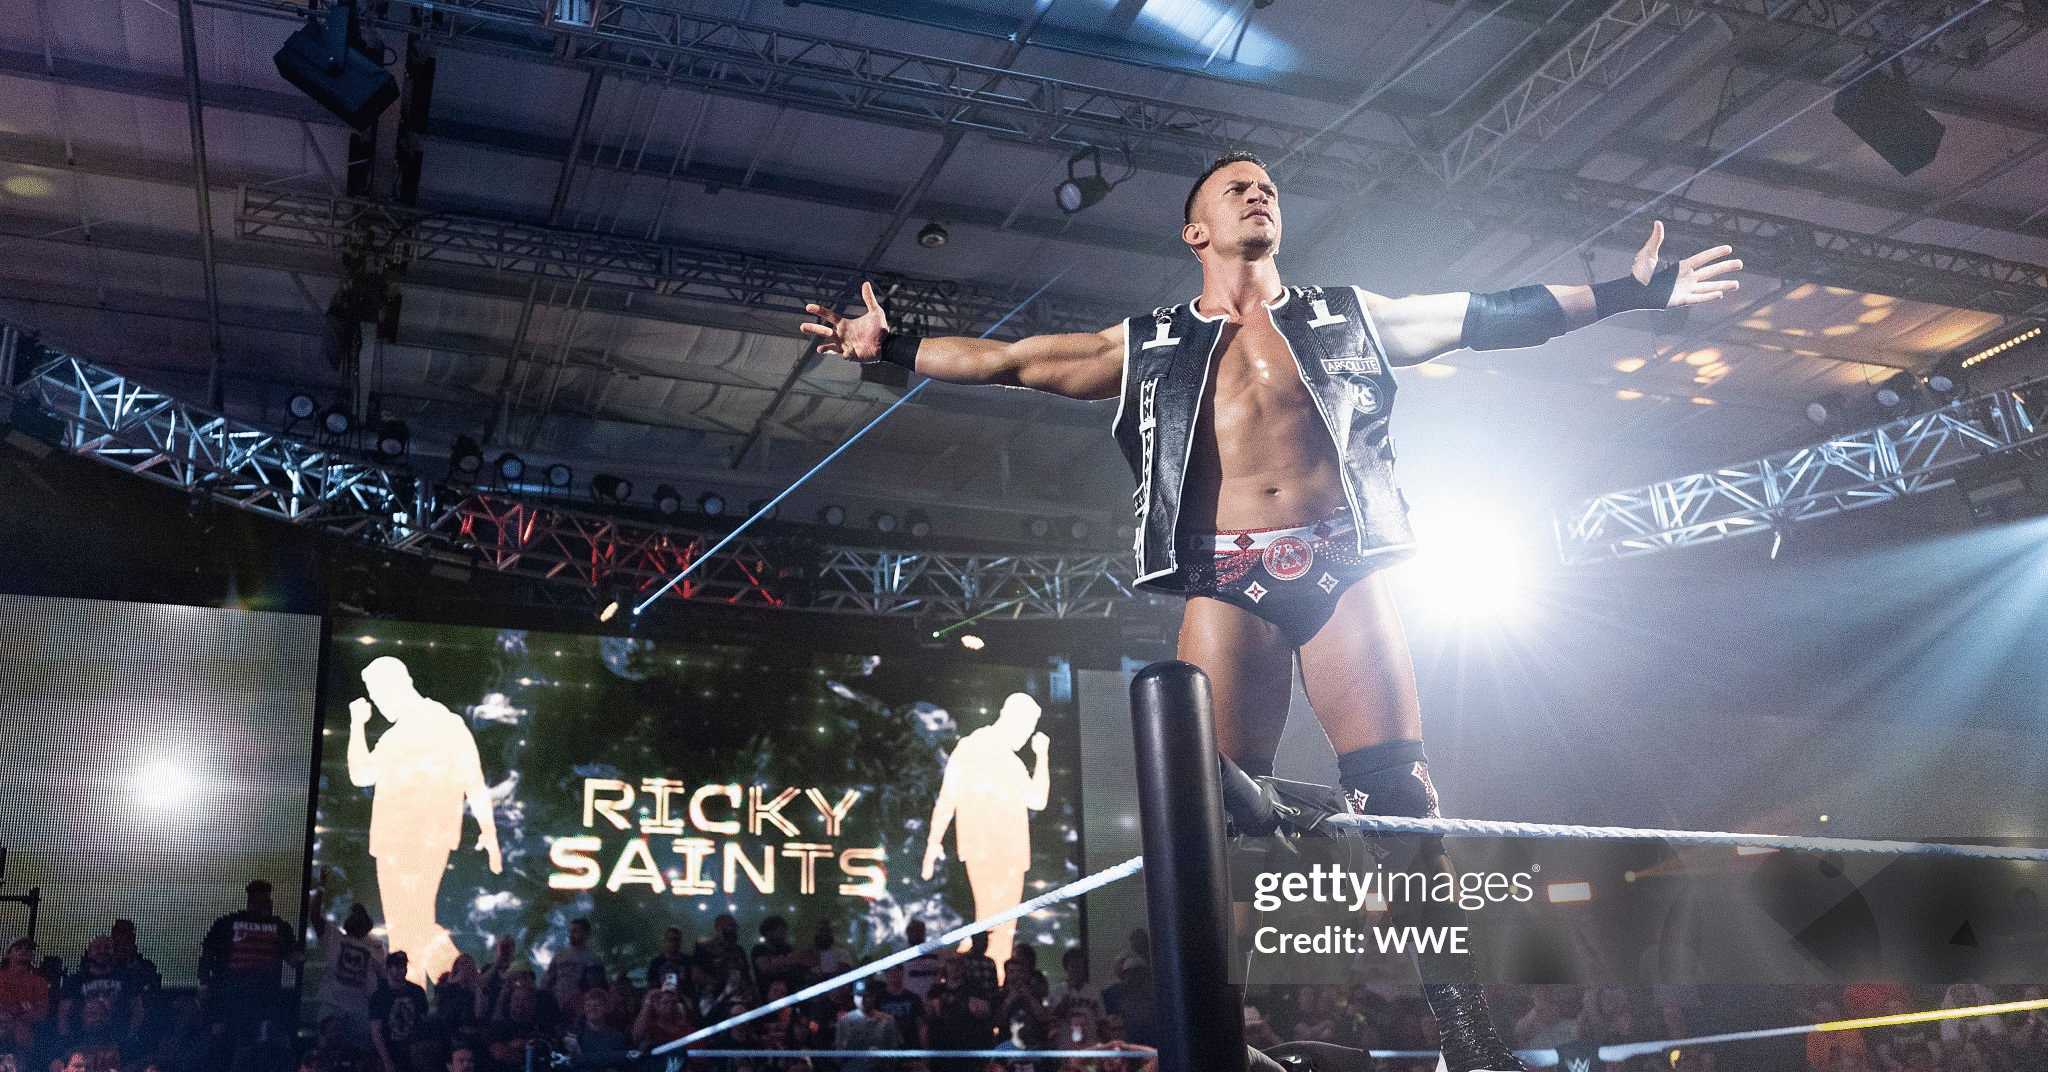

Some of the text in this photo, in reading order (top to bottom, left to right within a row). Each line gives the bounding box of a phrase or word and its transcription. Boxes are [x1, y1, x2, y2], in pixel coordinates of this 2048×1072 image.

[1327, 360, 1379, 372] ABSOLUTE
[582, 778, 861, 837] RICKY
[548, 837, 888, 899] SAINTS
